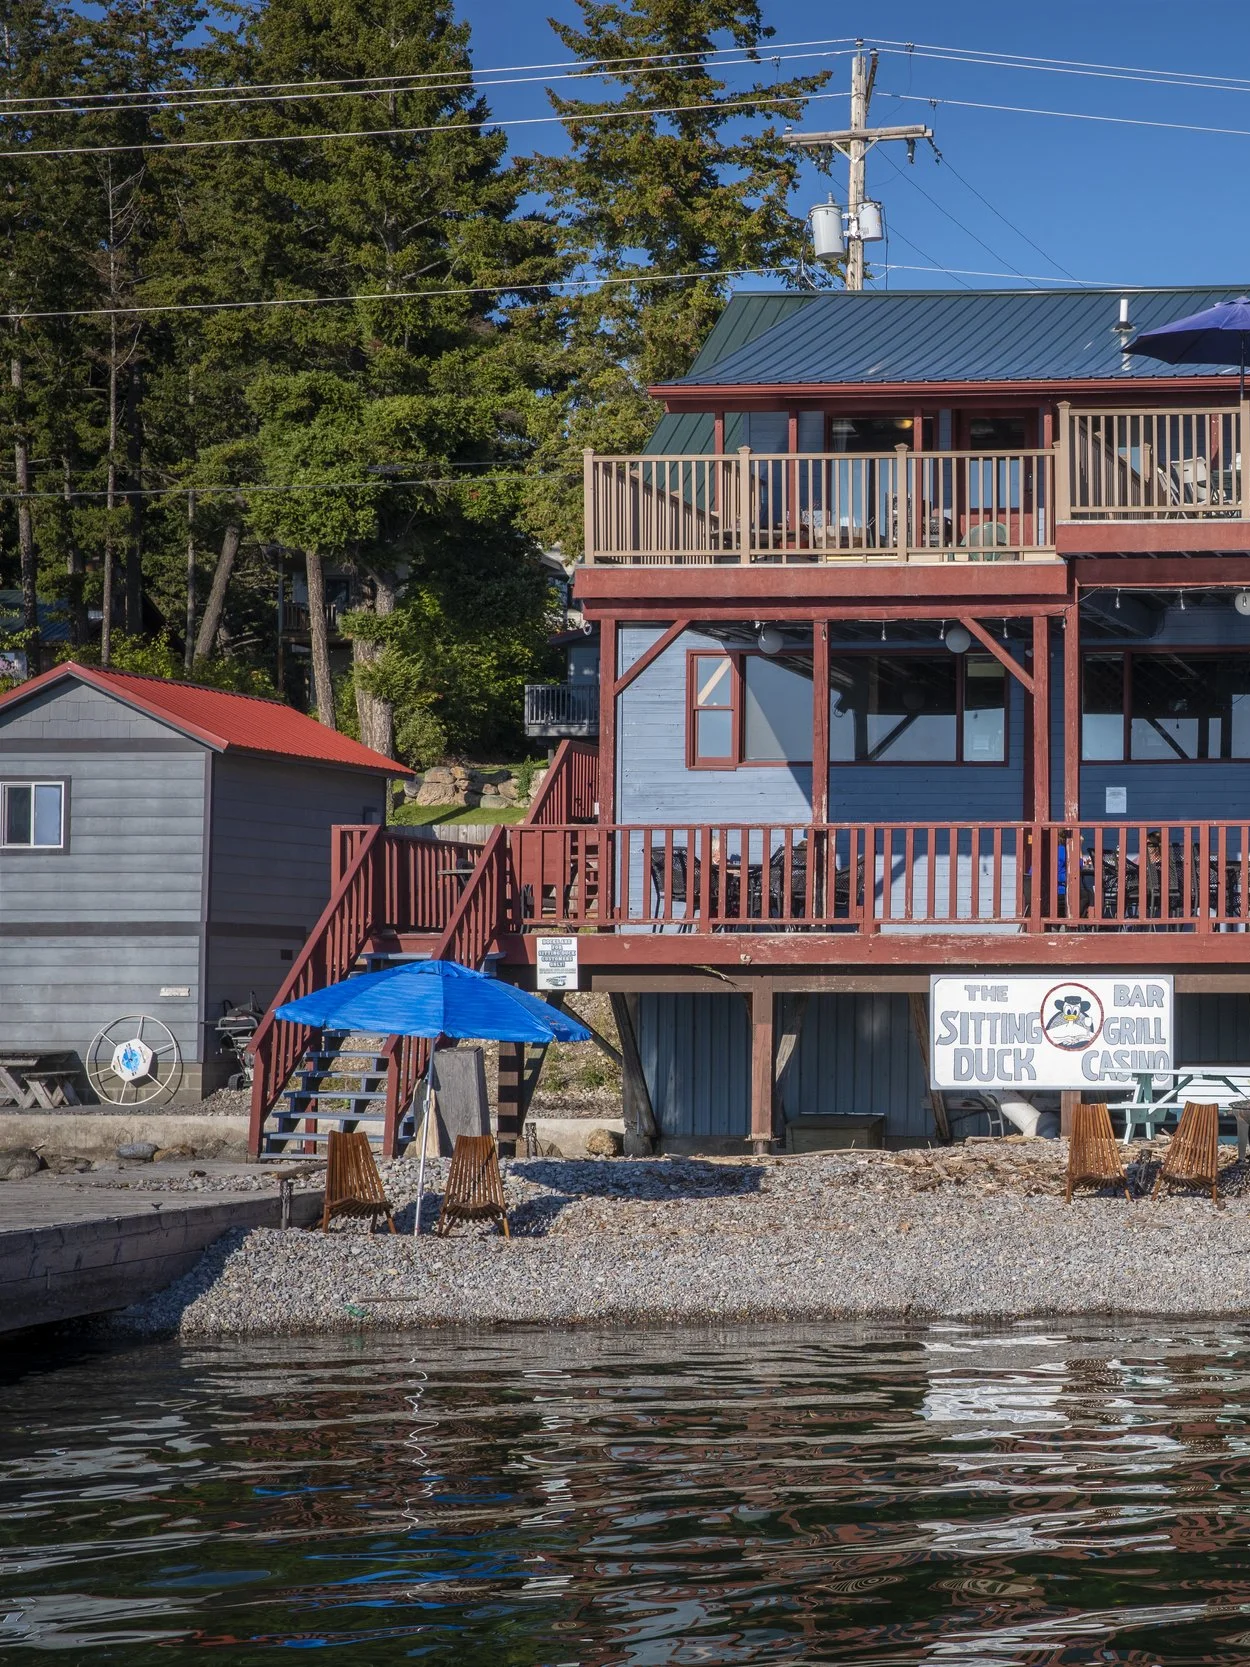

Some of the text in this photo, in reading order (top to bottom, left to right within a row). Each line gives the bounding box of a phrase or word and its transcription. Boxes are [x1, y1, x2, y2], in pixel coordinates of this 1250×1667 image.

[964, 984, 1009, 1003] THE
[1113, 984, 1165, 1008] BAR
[936, 1010, 1043, 1046] SITTING
[1103, 1017, 1167, 1046] GRILL
[953, 1047, 1037, 1082] DUCK
[1081, 1050, 1170, 1082] CASINO
